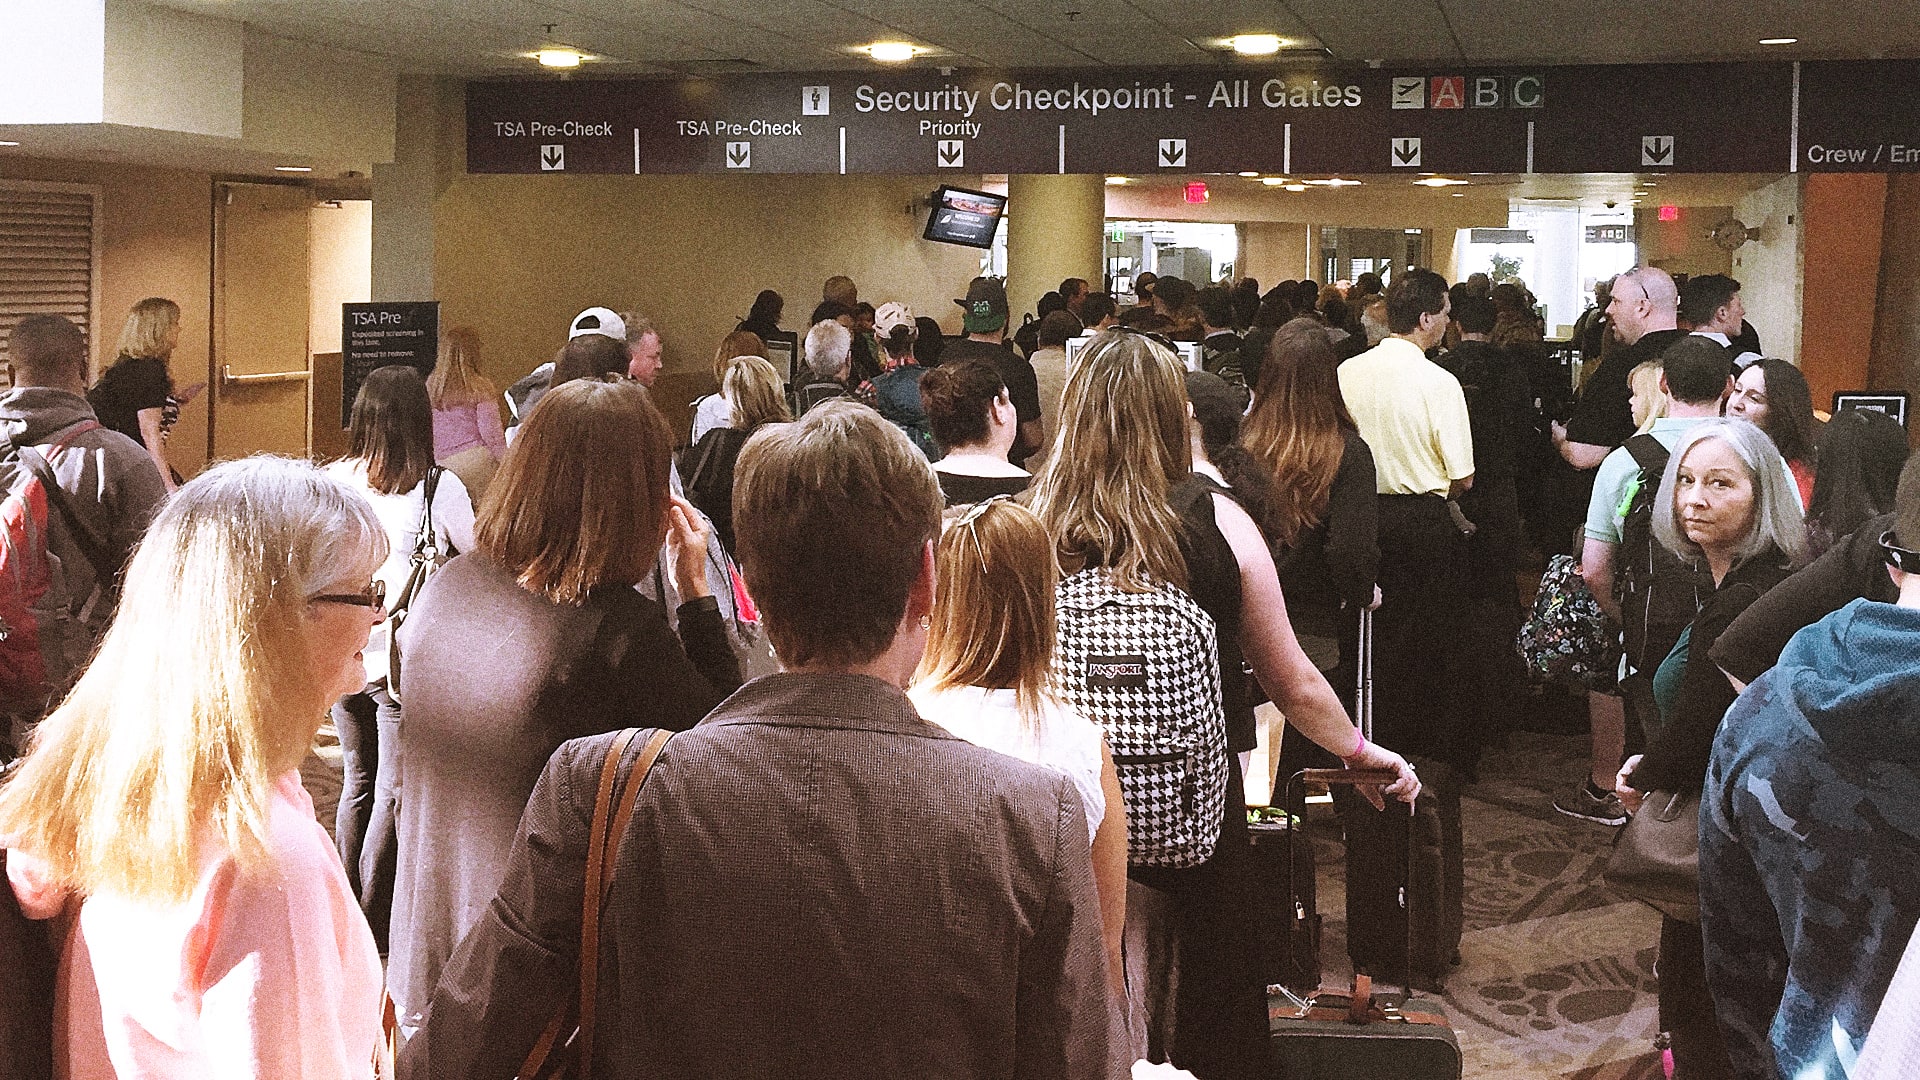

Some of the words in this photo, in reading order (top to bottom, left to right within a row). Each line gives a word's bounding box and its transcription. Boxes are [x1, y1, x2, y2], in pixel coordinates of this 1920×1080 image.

[855, 84, 980, 118] Security
[990, 81, 1174, 116] Checkpoint
[1208, 80, 1249, 108] All
[1261, 79, 1362, 108] Gates
[1434, 78, 1460, 107] A
[1475, 78, 1499, 106] B
[1513, 77, 1540, 106] C
[494, 122, 526, 137] TSA
[531, 121, 613, 137] Pre-Check
[677, 121, 710, 136] TSA
[716, 120, 802, 136] Pre-Check
[919, 120, 982, 139] Priority
[1808, 144, 1867, 163] Crew
[1873, 144, 1883, 163] /
[1891, 144, 1920, 163] Em
[352, 312, 377, 325] TSA
[380, 311, 402, 324] Pre
